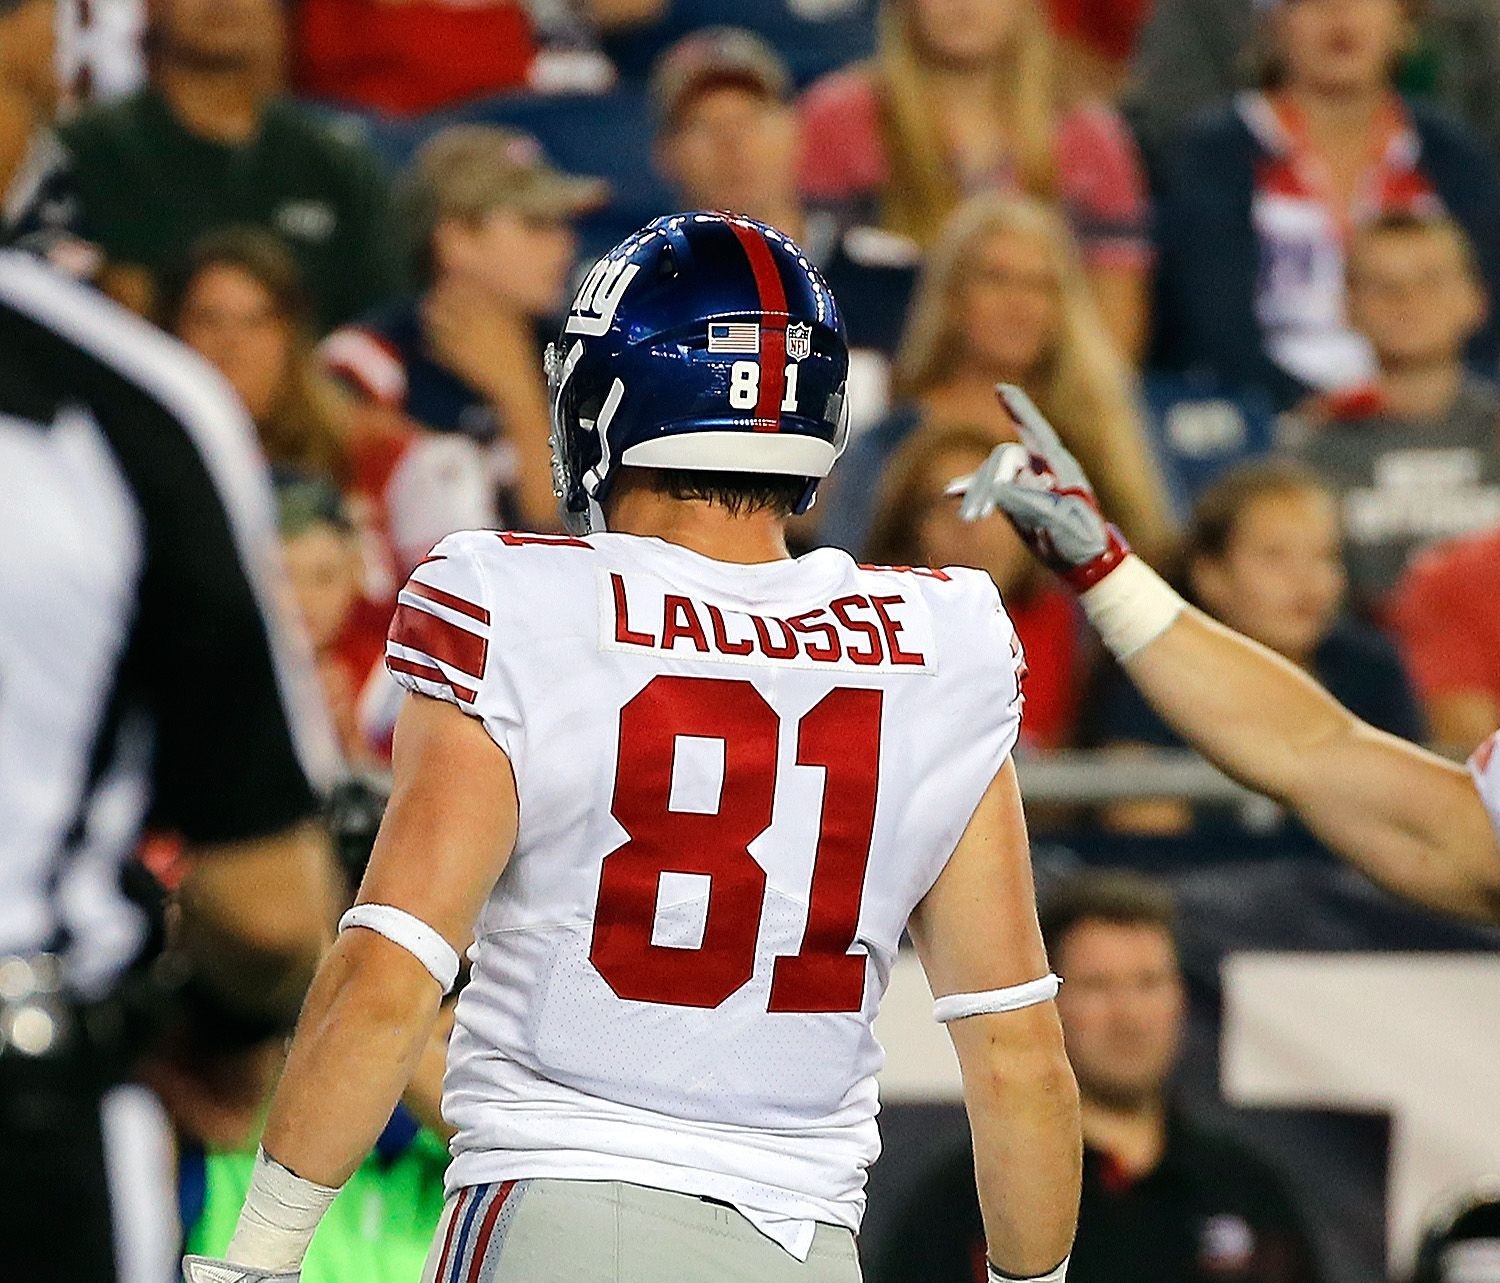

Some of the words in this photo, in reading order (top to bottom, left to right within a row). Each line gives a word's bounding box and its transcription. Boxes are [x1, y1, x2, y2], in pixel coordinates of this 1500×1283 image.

[729, 361, 799, 412] 81
[611, 573, 925, 666] LACOSSE
[588, 674, 884, 1014] 81
